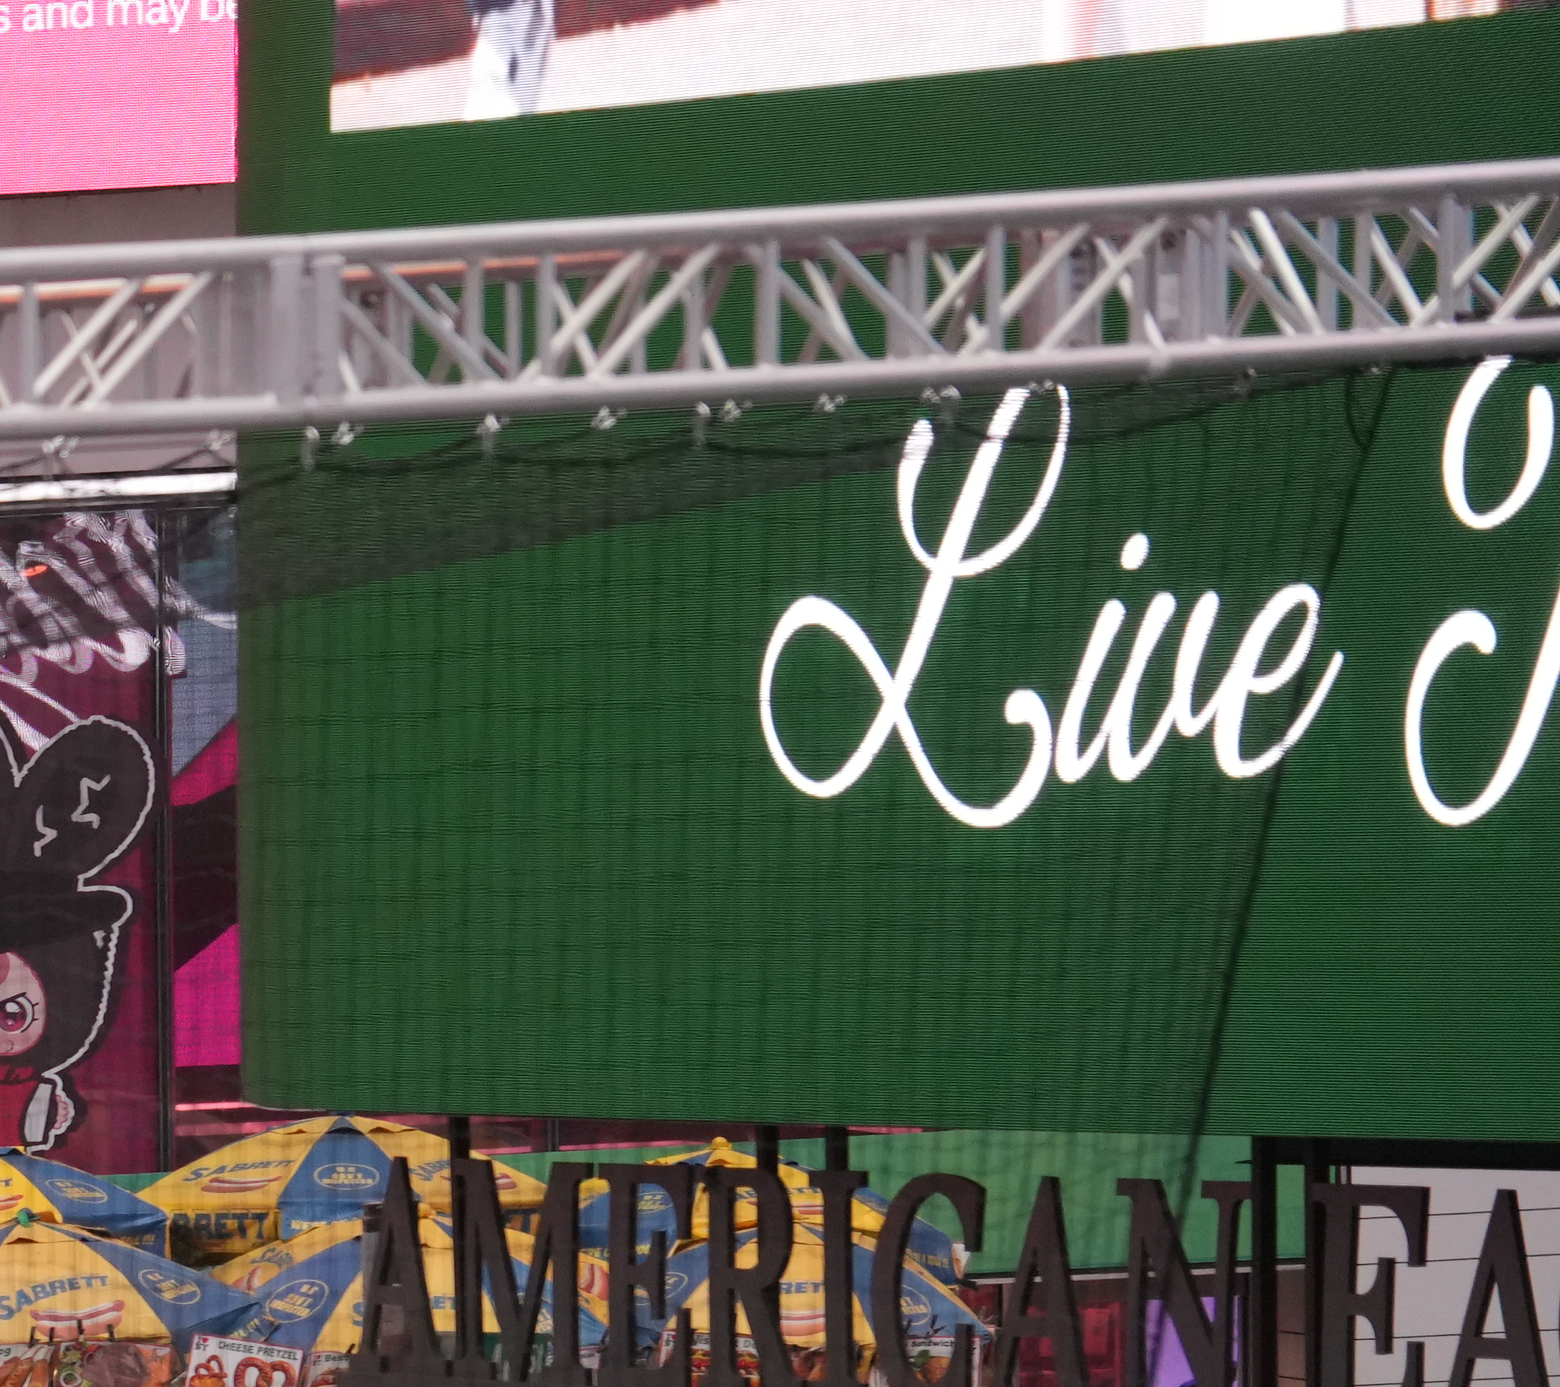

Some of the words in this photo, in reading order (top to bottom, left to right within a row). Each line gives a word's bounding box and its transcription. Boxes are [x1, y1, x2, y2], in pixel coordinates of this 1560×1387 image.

[22, 0, 97, 33] and
[108, 0, 197, 34] may
[760, 384, 1344, 829] Live
[182, 1158, 297, 1182] SABRETT
[217, 1339, 255, 1355] CHEESE
[256, 1345, 300, 1361] PRETZEL
